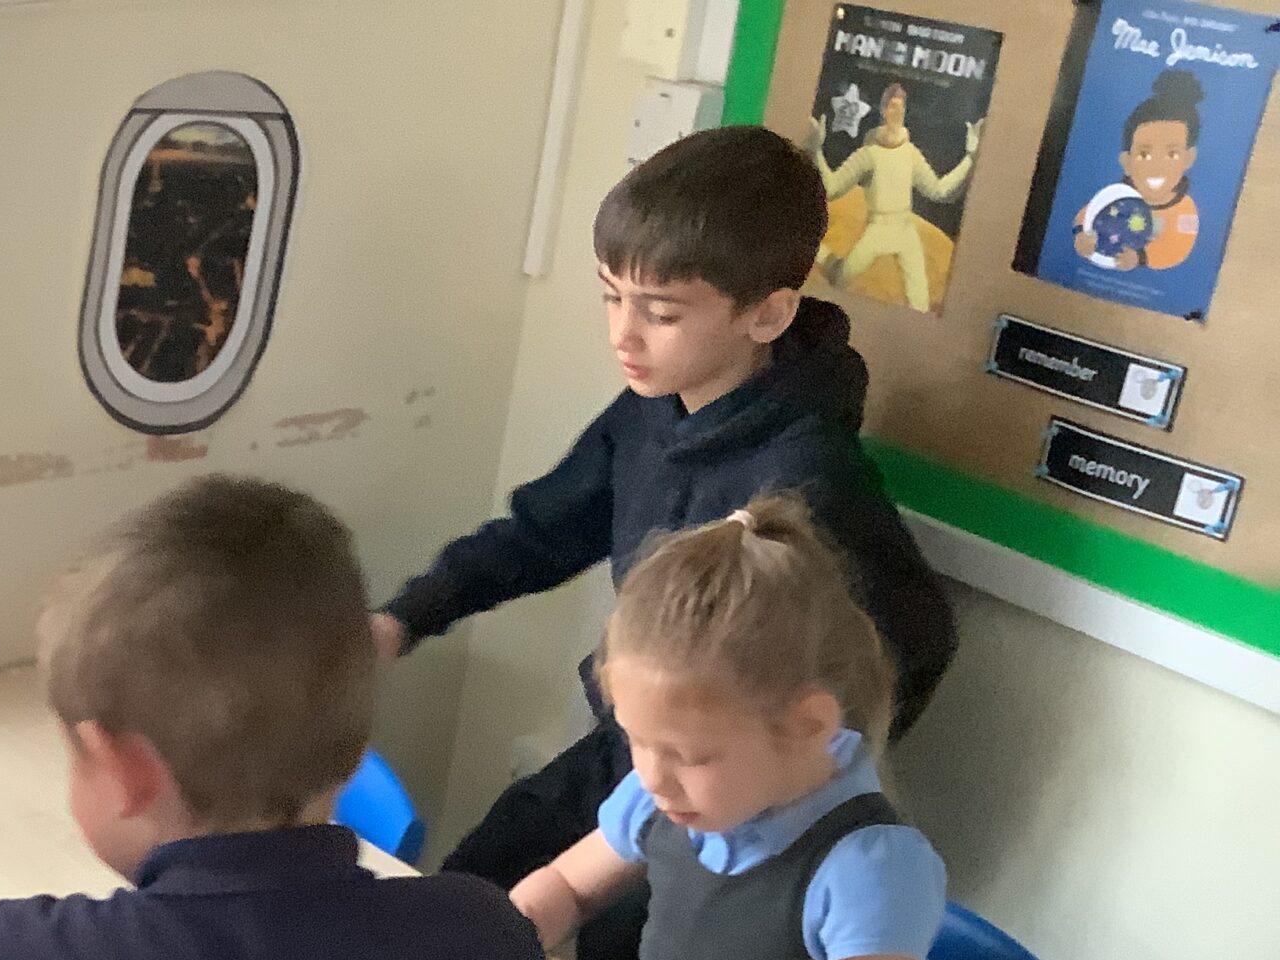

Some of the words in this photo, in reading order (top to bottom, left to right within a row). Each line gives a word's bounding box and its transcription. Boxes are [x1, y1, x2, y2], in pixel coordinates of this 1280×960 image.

[835, 30, 885, 59] MAN
[912, 46, 986, 80] MOON
[1112, 18, 1160, 57] Mae
[1166, 28, 1259, 69] Jemison
[1019, 347, 1098, 382] remember
[1068, 452, 1151, 499] memory
